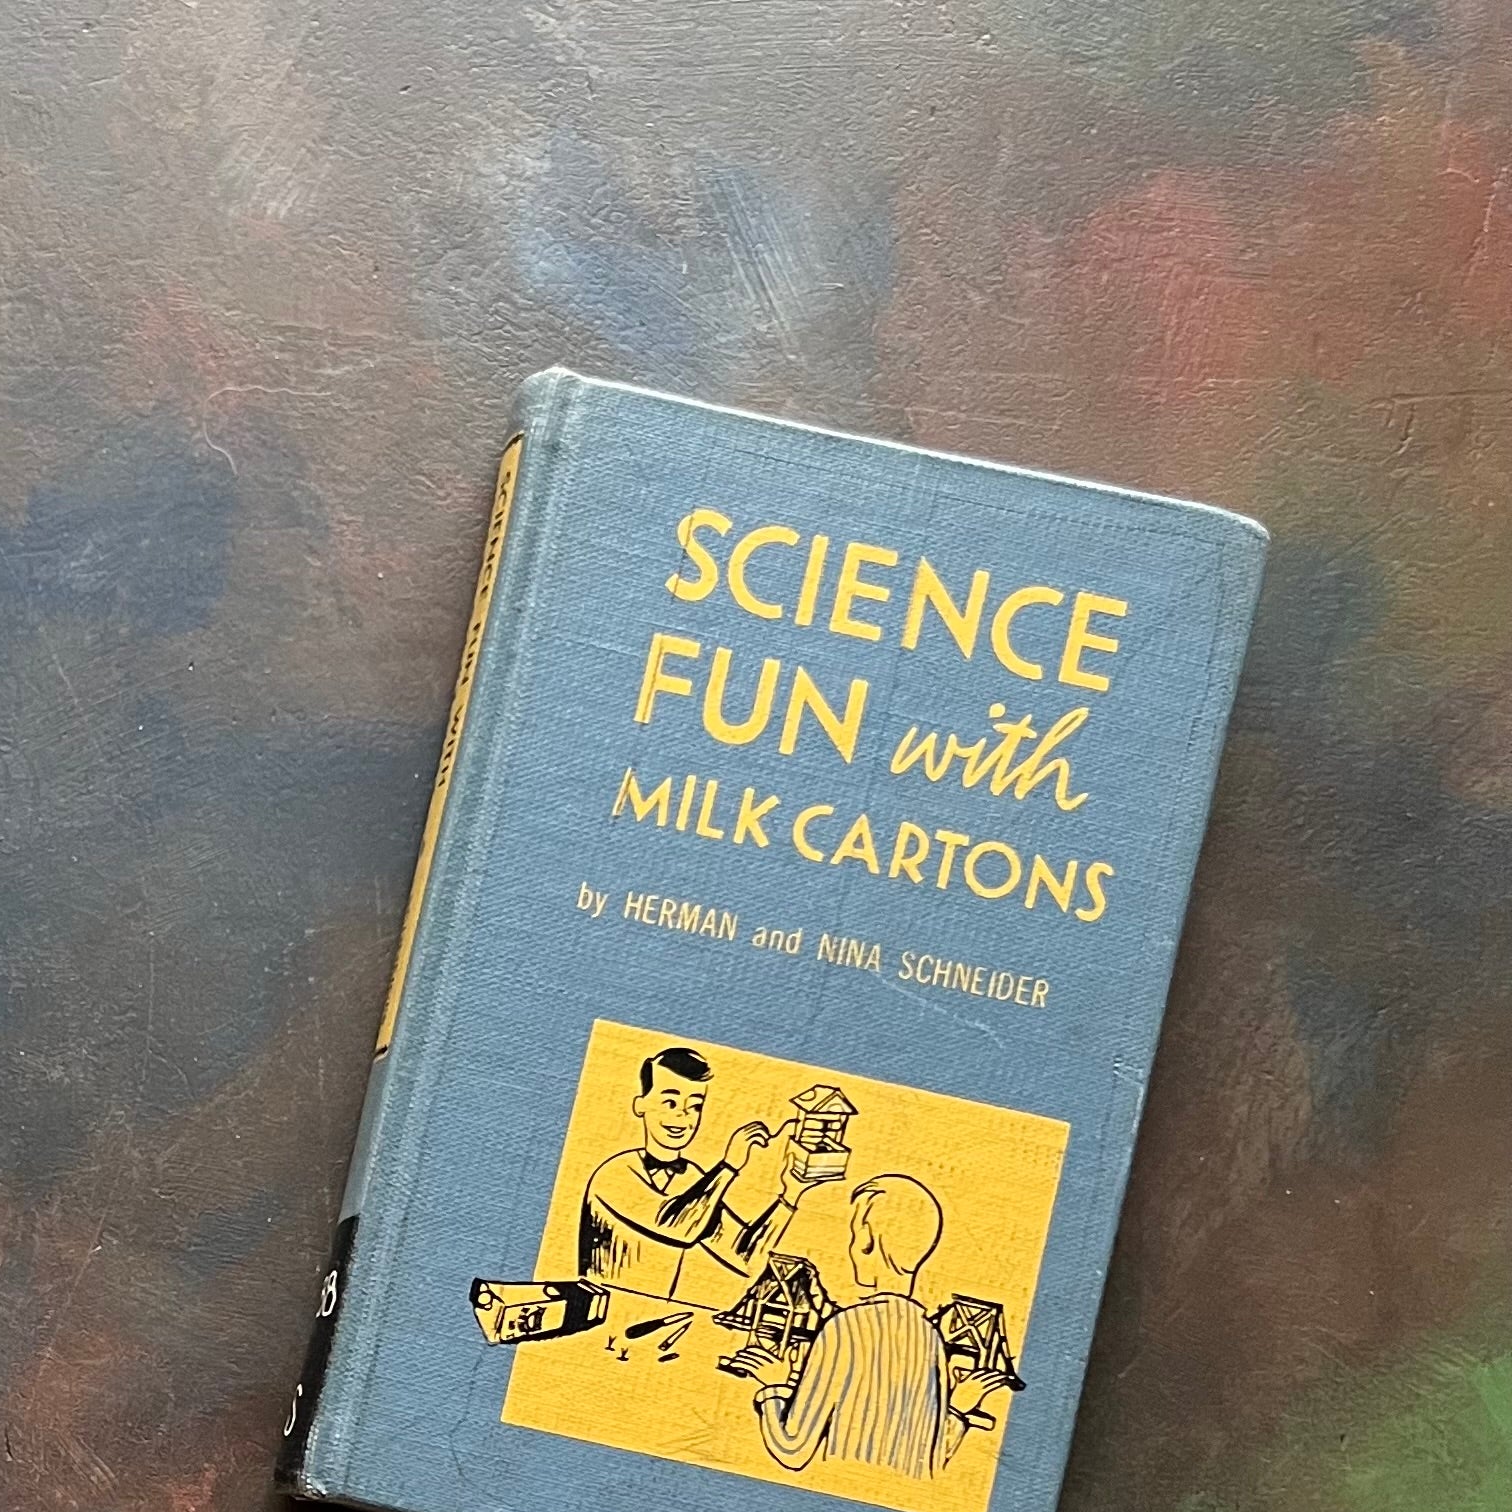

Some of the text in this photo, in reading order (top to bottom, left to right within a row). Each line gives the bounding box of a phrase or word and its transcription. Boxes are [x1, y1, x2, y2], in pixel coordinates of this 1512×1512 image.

[437, 469, 512, 788] SCIENCE FUN WITH
[665, 508, 1128, 691] SCIENCE
[633, 632, 1089, 810] FUN with
[612, 767, 1115, 923] MILK CARTONS
[577, 883, 1051, 1009] by HERMAN and NINA SCHNEIDER
